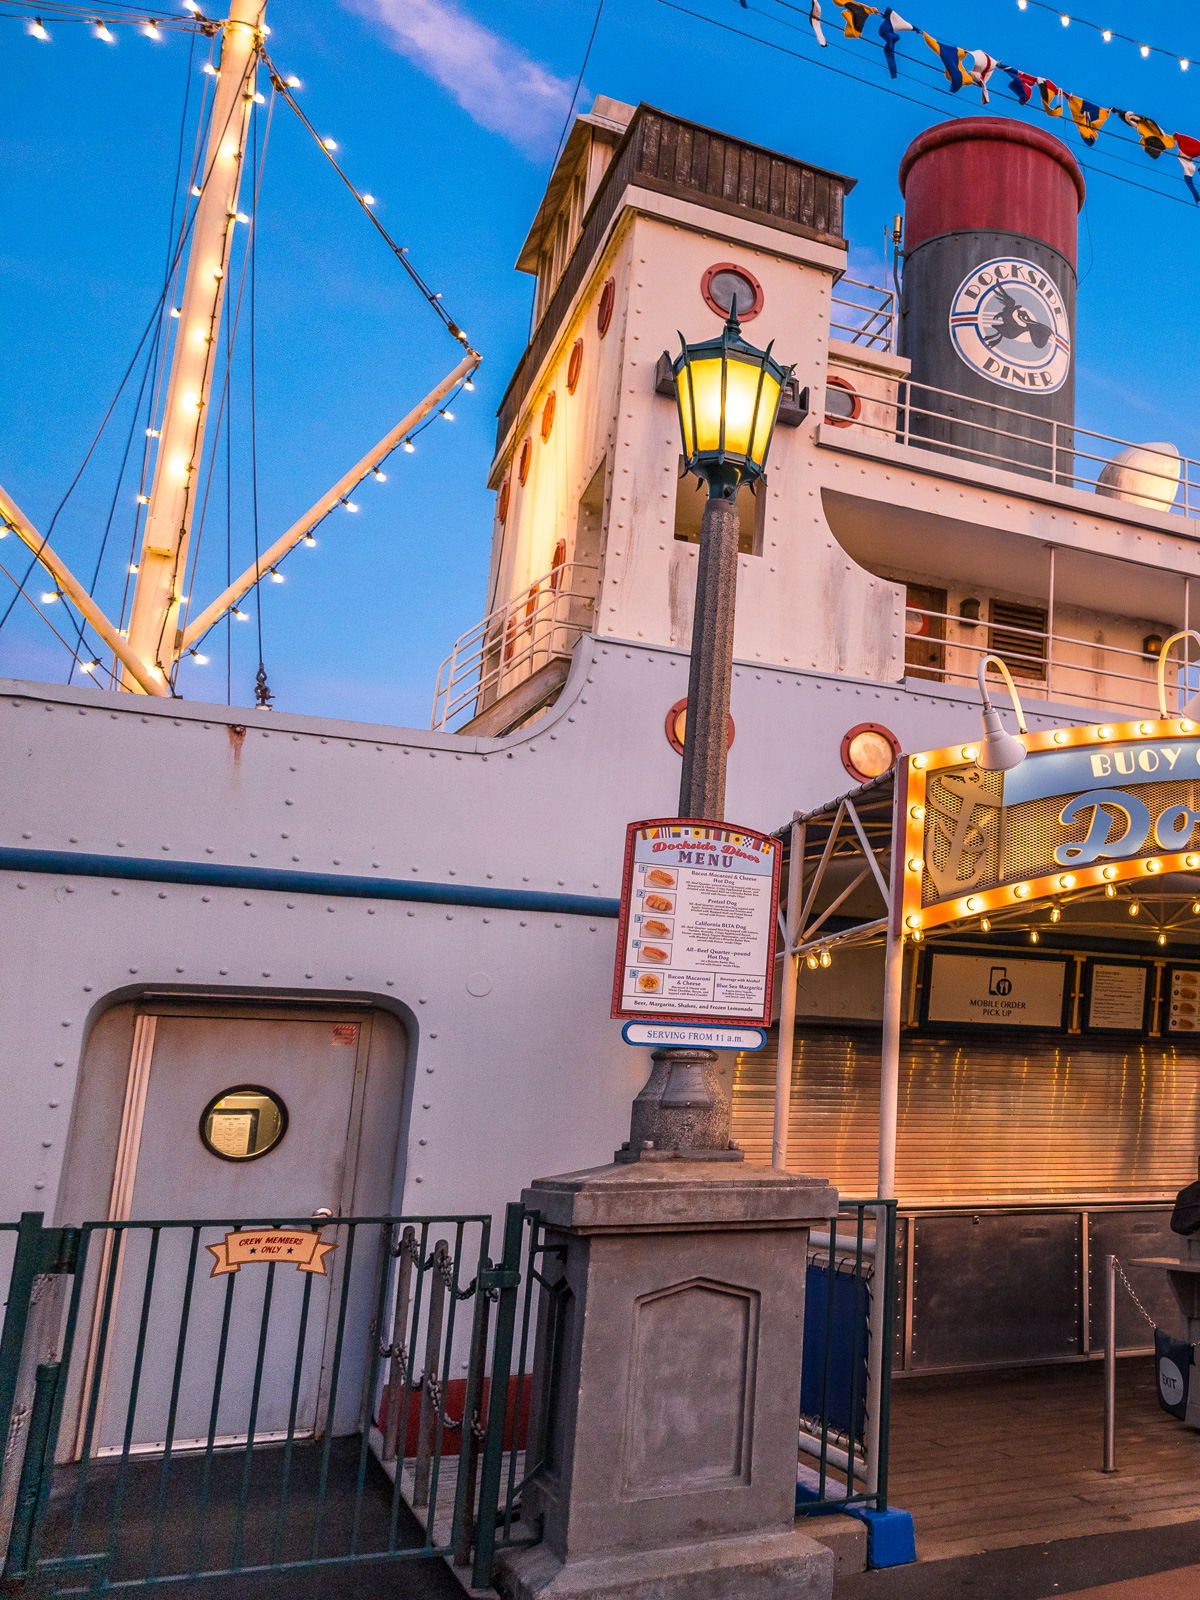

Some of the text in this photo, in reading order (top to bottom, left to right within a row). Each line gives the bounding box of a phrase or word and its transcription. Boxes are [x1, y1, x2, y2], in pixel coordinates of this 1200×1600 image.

[964, 264, 1064, 320] DOCKSIDE
[982, 357, 1053, 386] DINER
[1090, 747, 1182, 777] BUOY
[652, 840, 760, 863] Dockside Diner
[678, 851, 733, 868] MENU
[1000, 1001, 1026, 1009] ORDER
[647, 1030, 686, 1039] SERVING
[239, 1237, 304, 1246] CREW MEMBERS
[261, 1246, 282, 1254] ONLY
[1162, 1373, 1177, 1389] EXIT
